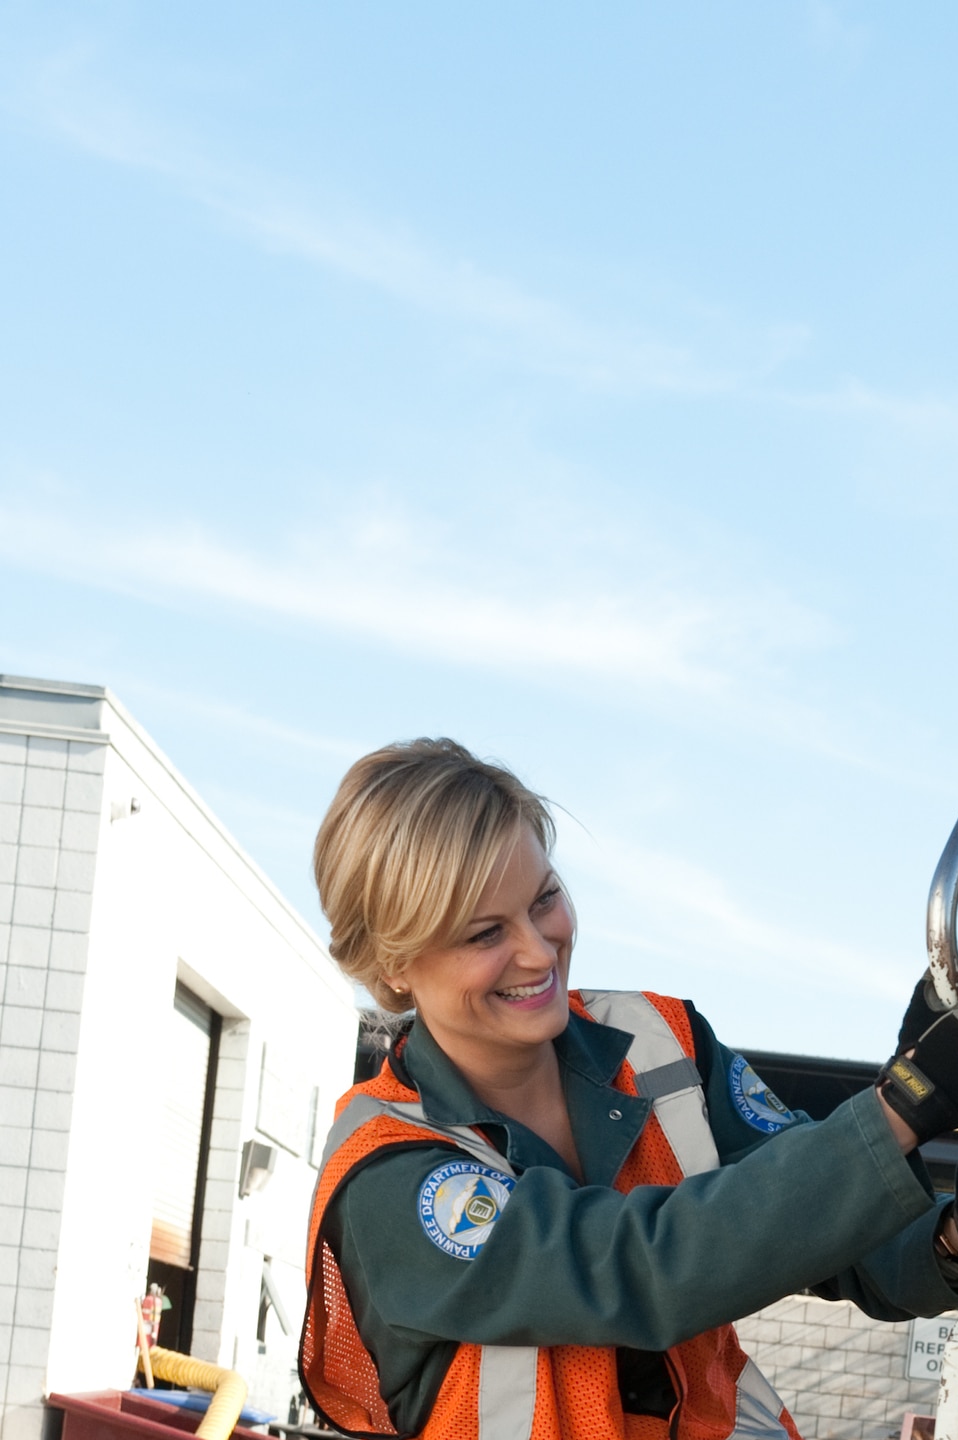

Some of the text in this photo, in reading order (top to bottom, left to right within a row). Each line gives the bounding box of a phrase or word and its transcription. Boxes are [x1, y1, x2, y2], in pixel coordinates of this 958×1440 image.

[732, 1070, 755, 1120] PAWNEE
[422, 1164, 507, 1216] DEPARTMENT OF
[425, 1217, 470, 1258] PAWNEE
